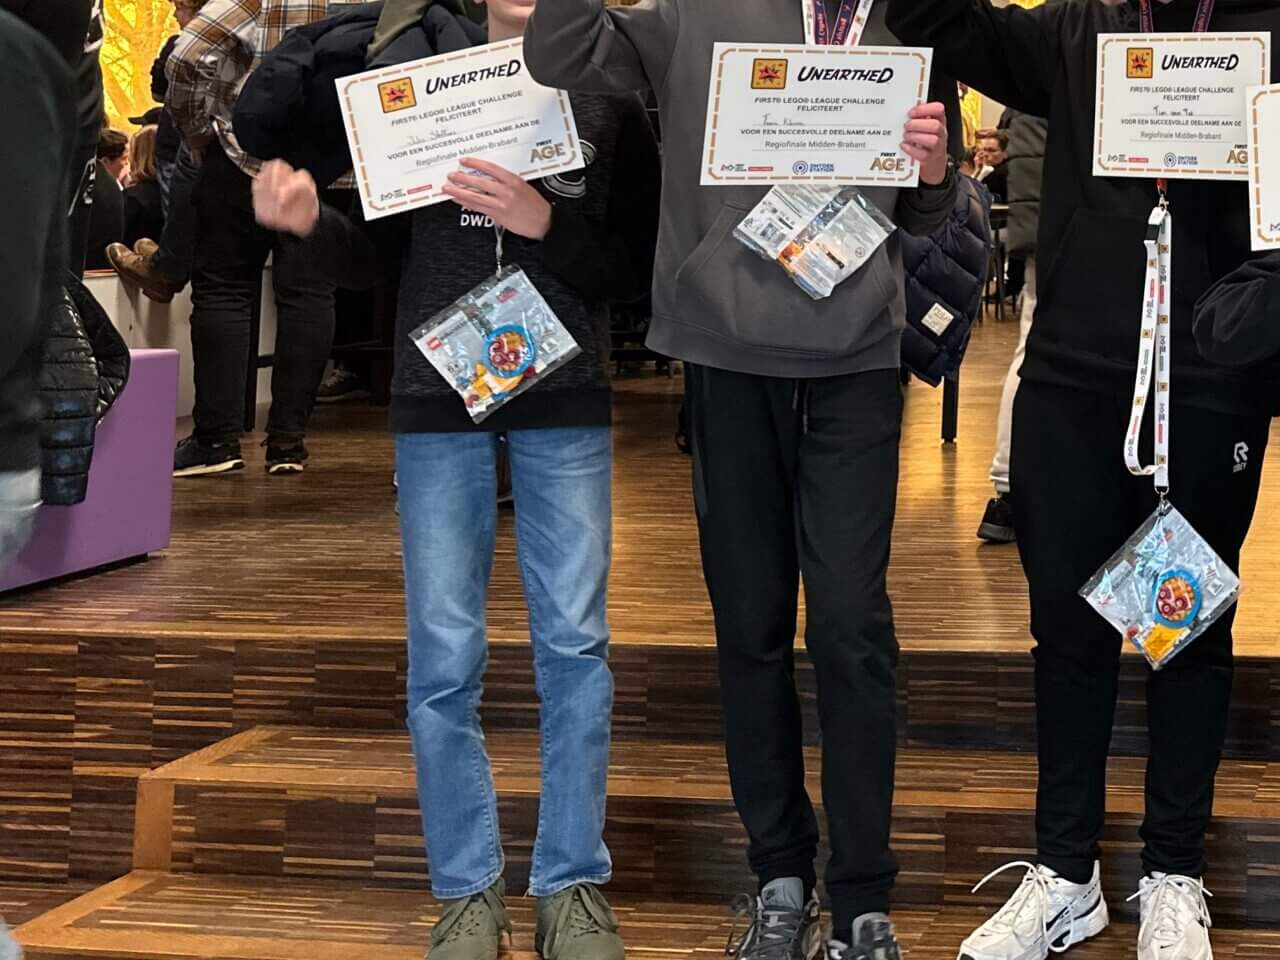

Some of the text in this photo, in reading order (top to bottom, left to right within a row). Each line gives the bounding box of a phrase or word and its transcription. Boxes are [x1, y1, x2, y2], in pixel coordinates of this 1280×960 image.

[1161, 54, 1239, 71] UNEARTHED
[425, 59, 521, 95] UNEARTHED
[797, 66, 894, 84] UNEARTHED
[530, 142, 566, 163] AGE
[765, 141, 807, 149] Regiofinale
[869, 157, 906, 171] AGE
[1226, 150, 1248, 165] AG
